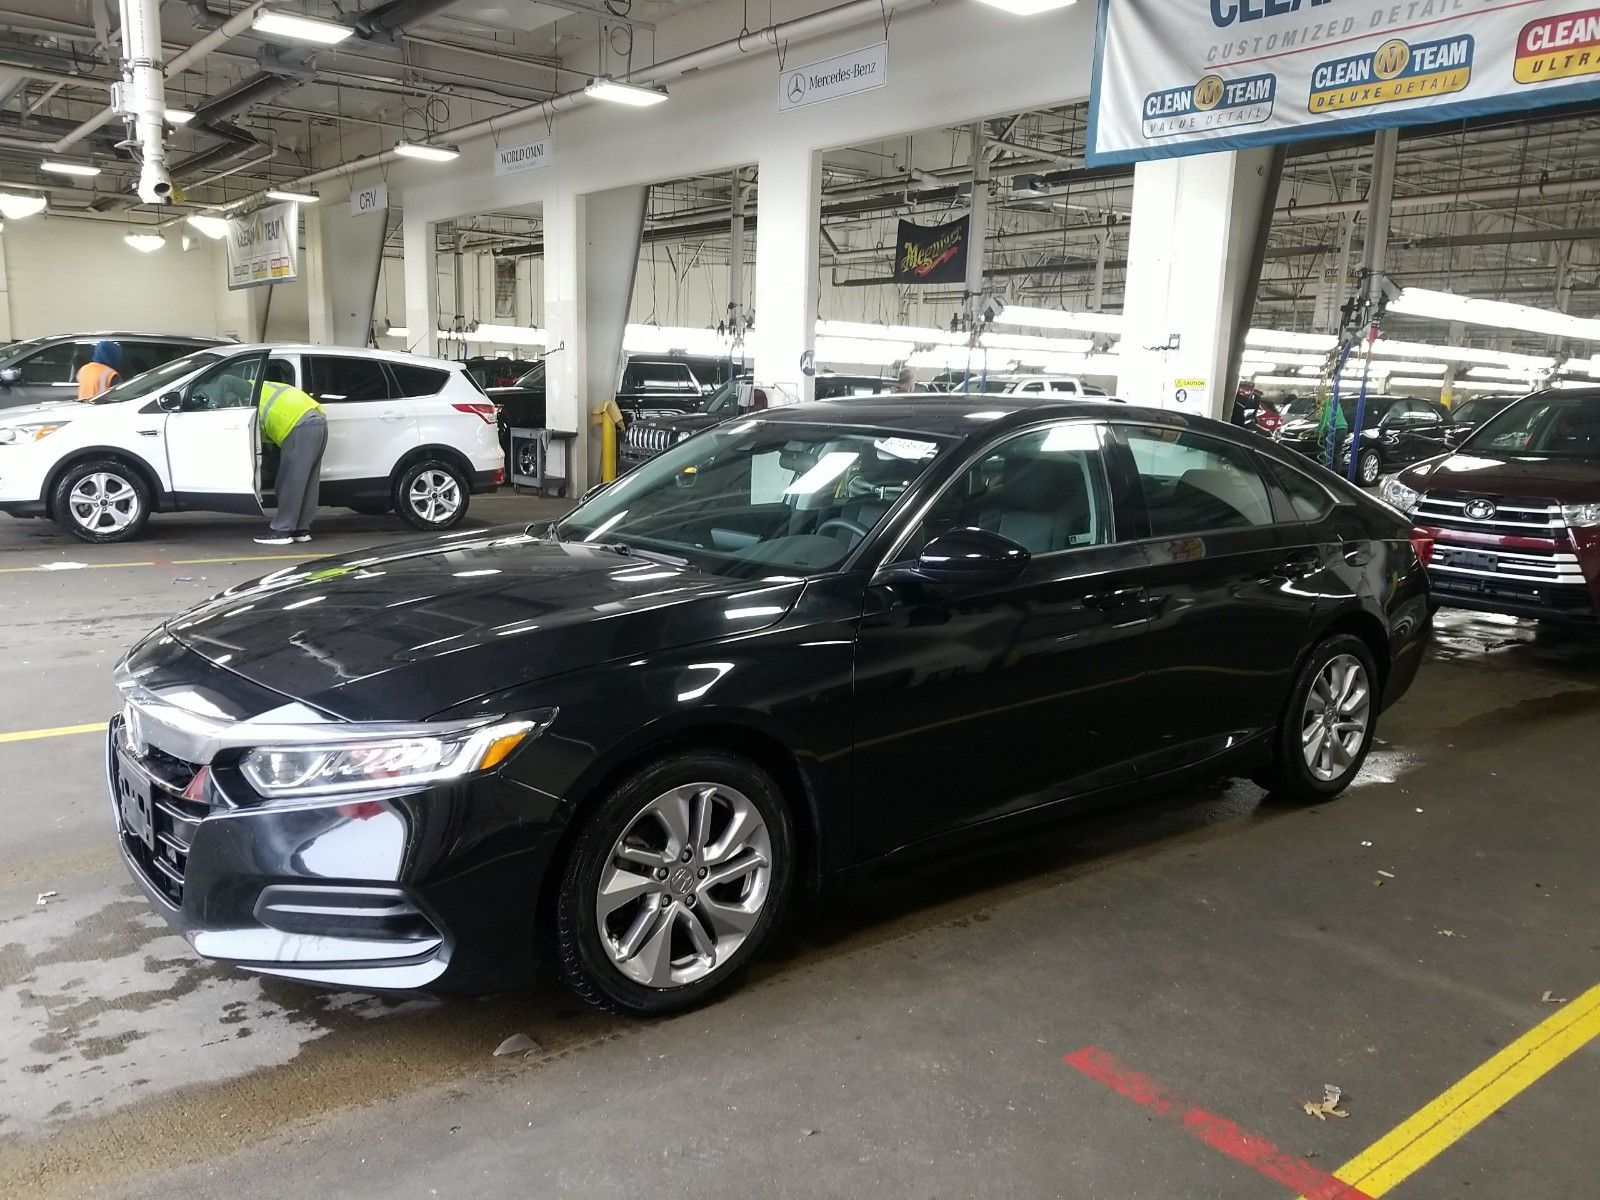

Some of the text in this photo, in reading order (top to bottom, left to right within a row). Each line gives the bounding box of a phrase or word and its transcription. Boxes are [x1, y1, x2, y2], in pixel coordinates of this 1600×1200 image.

[1207, 17, 1355, 62] CUSTOMIZED
[1526, 16, 1600, 52] CLEAN
[809, 62, 877, 91] Mercedes-Benz
[1315, 58, 1371, 88] CLEAN
[1412, 39, 1468, 72] TEAM
[1532, 52, 1600, 74] ULTR
[1146, 90, 1192, 116] CLEAN
[1226, 78, 1272, 104] TEAM
[1316, 74, 1458, 107] DELUXE DETAIL
[1150, 106, 1262, 133] VALUE DETAIL
[359, 189, 377, 210] CRV
